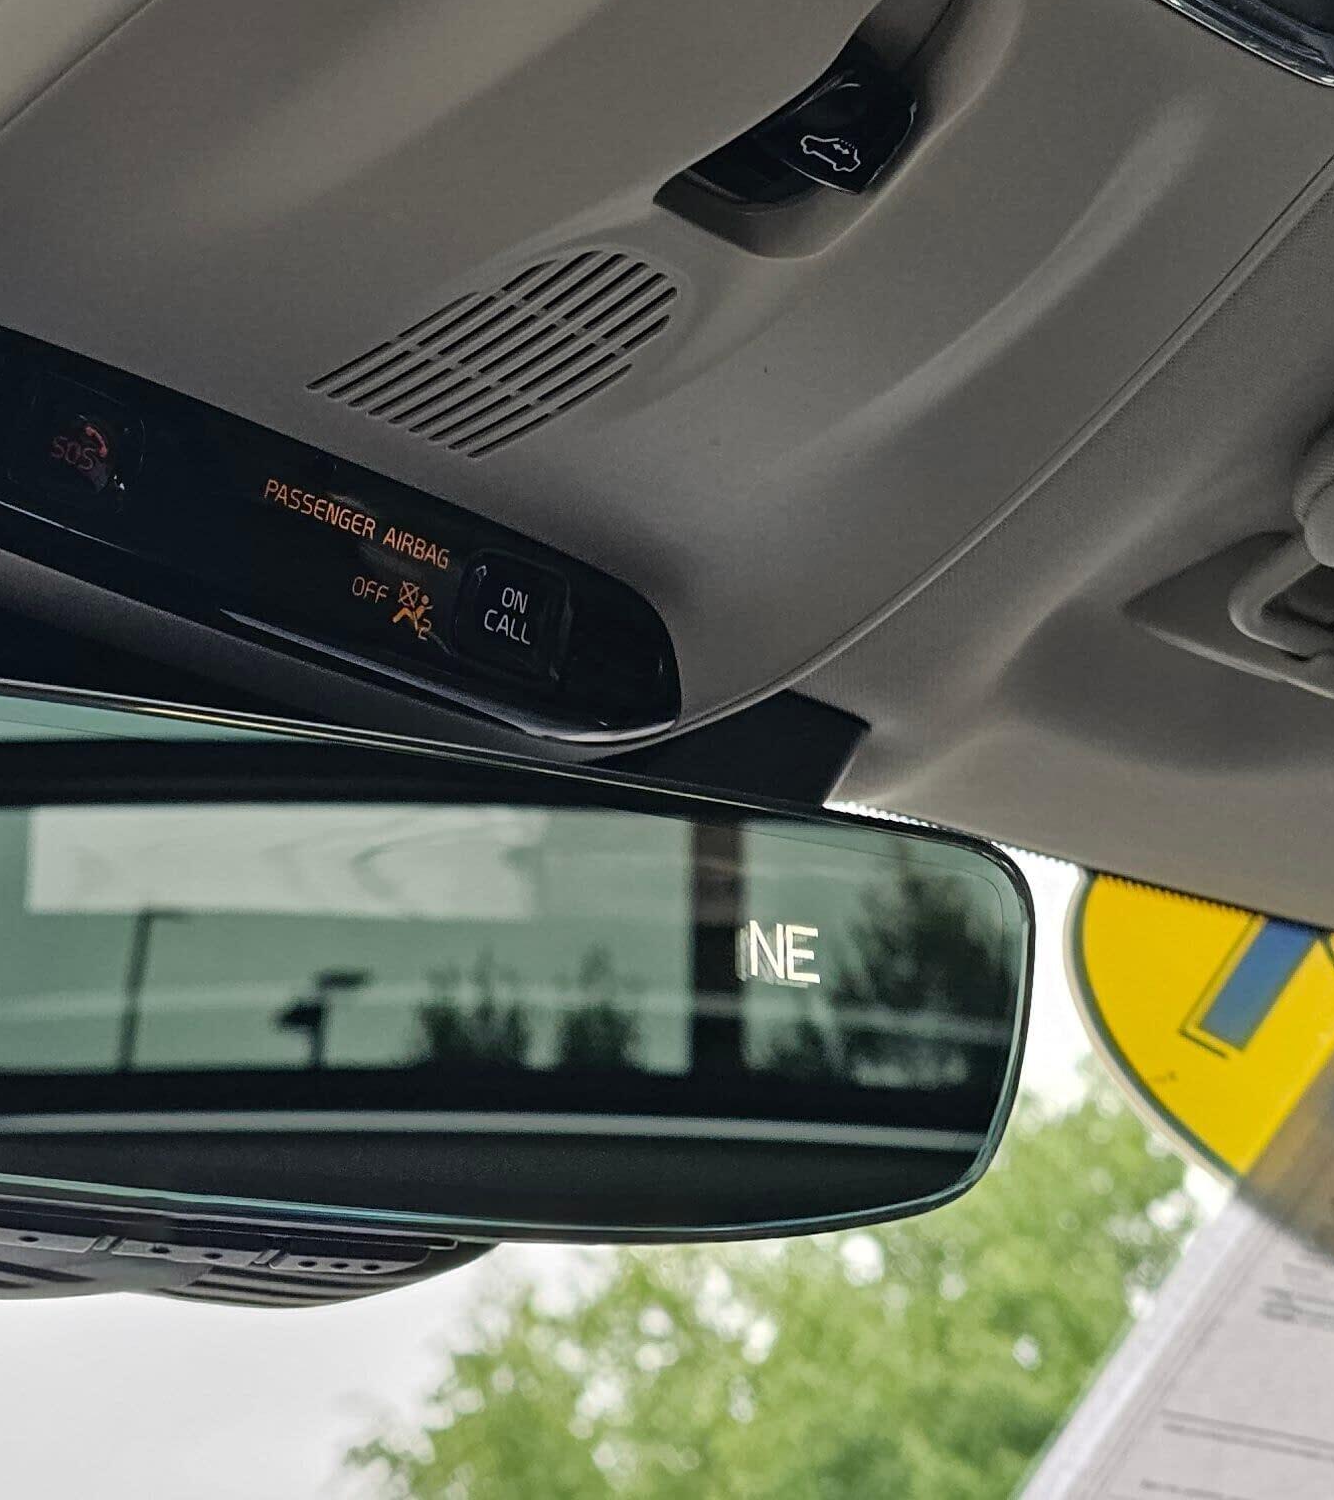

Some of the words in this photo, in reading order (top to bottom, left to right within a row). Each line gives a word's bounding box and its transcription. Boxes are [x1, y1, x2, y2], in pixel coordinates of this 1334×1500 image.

[50, 435, 96, 471] SOS
[264, 479, 376, 540] PASSENGER
[382, 526, 450, 570] AIRBAG
[352, 576, 389, 603] OFF
[501, 586, 529, 615] ON
[484, 608, 531, 645] CALL
[748, 918, 821, 985] NE
